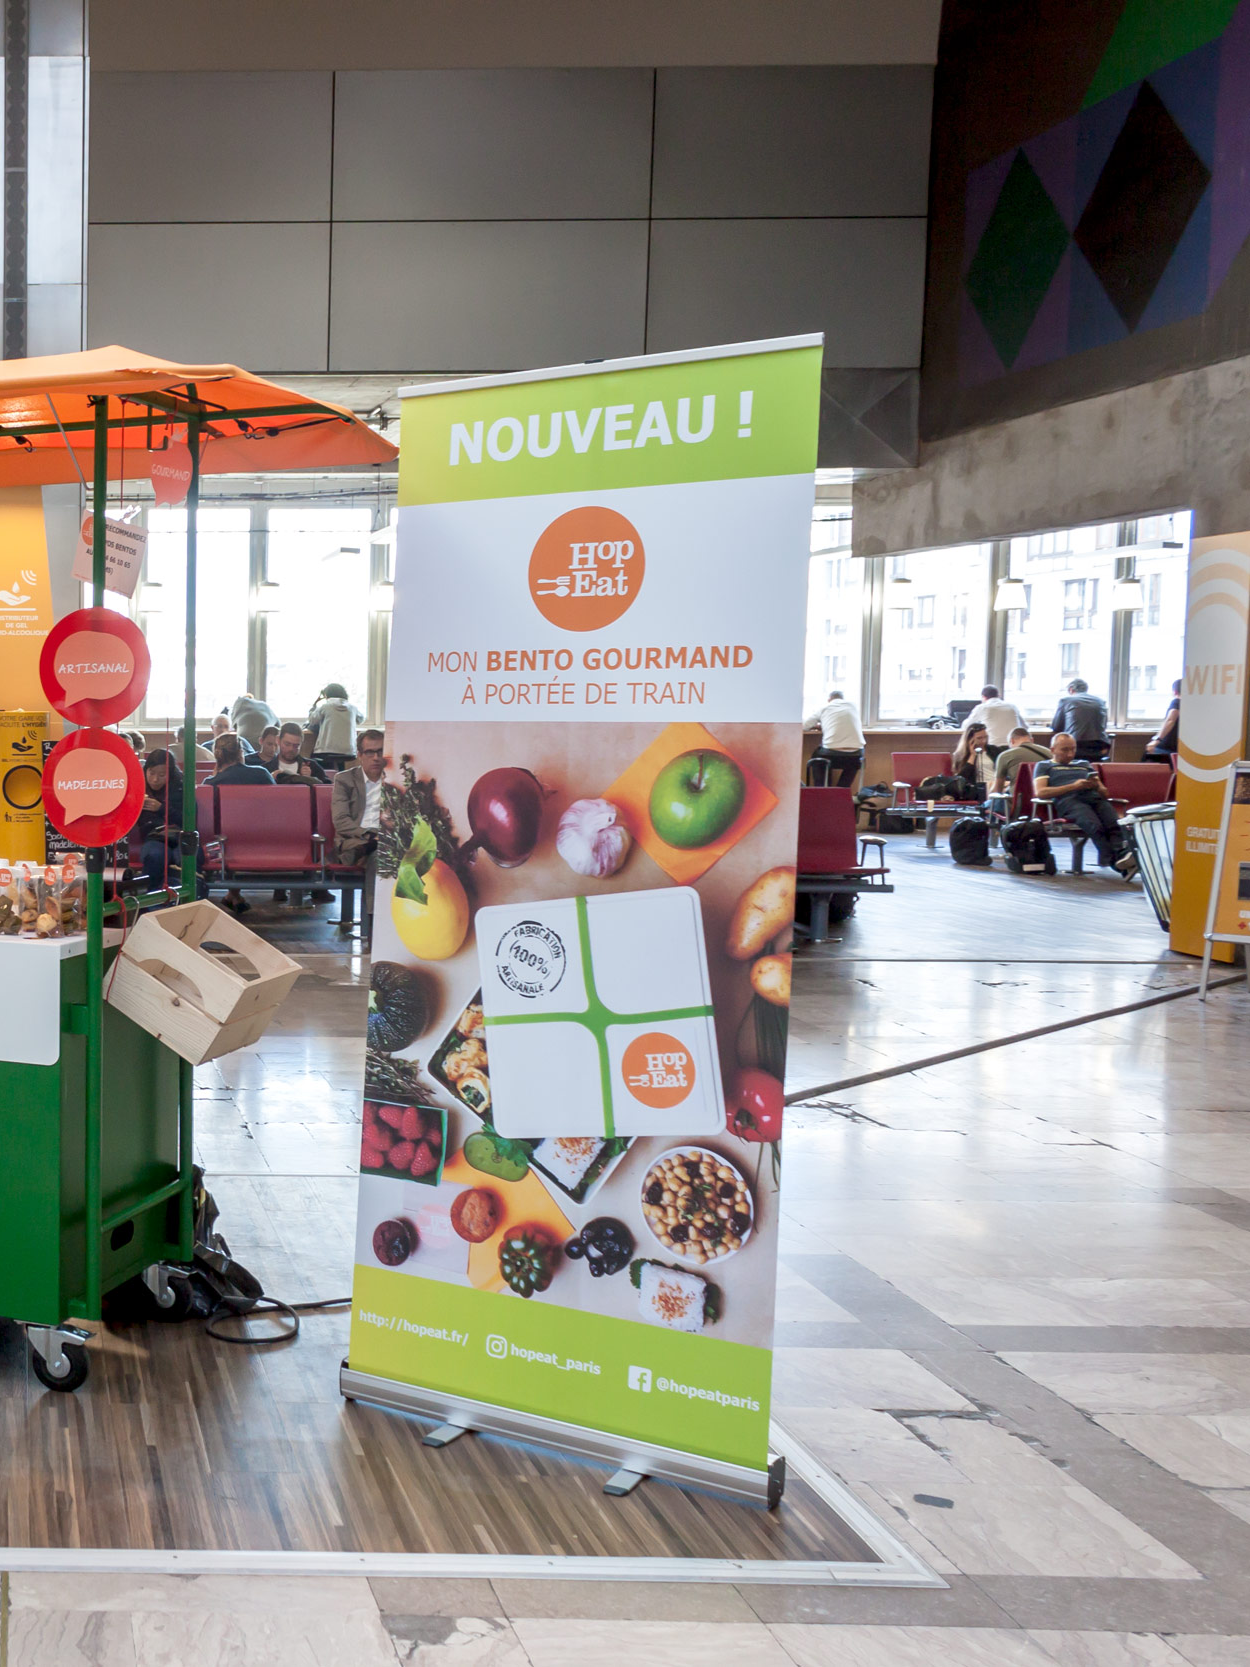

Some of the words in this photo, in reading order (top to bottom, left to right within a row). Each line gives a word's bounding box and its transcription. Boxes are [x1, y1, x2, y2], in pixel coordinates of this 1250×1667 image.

[449, 394, 717, 467] NOUVEAU
[737, 390, 754, 438] !
[151, 463, 191, 482] GOURMAND
[115, 543, 137, 556] BENTOS
[568, 539, 635, 569] Hop
[570, 569, 629, 598] Eat
[58, 662, 130, 674] ARTISANAL
[428, 651, 478, 673] MON
[486, 648, 574, 672] BENTO
[582, 645, 754, 671] GOURMAND
[461, 676, 476, 705] À
[484, 675, 576, 705] PORTÉE
[585, 682, 618, 705] DE
[626, 681, 706, 705] TRAIN
[1184, 663, 1242, 695] WIFI
[57, 778, 126, 790] MADELEINES
[514, 925, 561, 959] FABRICATION
[513, 945, 548, 974] 100%
[501, 965, 545, 994] ARTISANALE
[644, 1052, 688, 1071] Hop
[649, 1070, 688, 1088] Eat
[359, 1309, 469, 1347] http://hopeat.fr/
[510, 1343, 601, 1375] hopeat_paris
[656, 1376, 760, 1412] @hopeatparis
